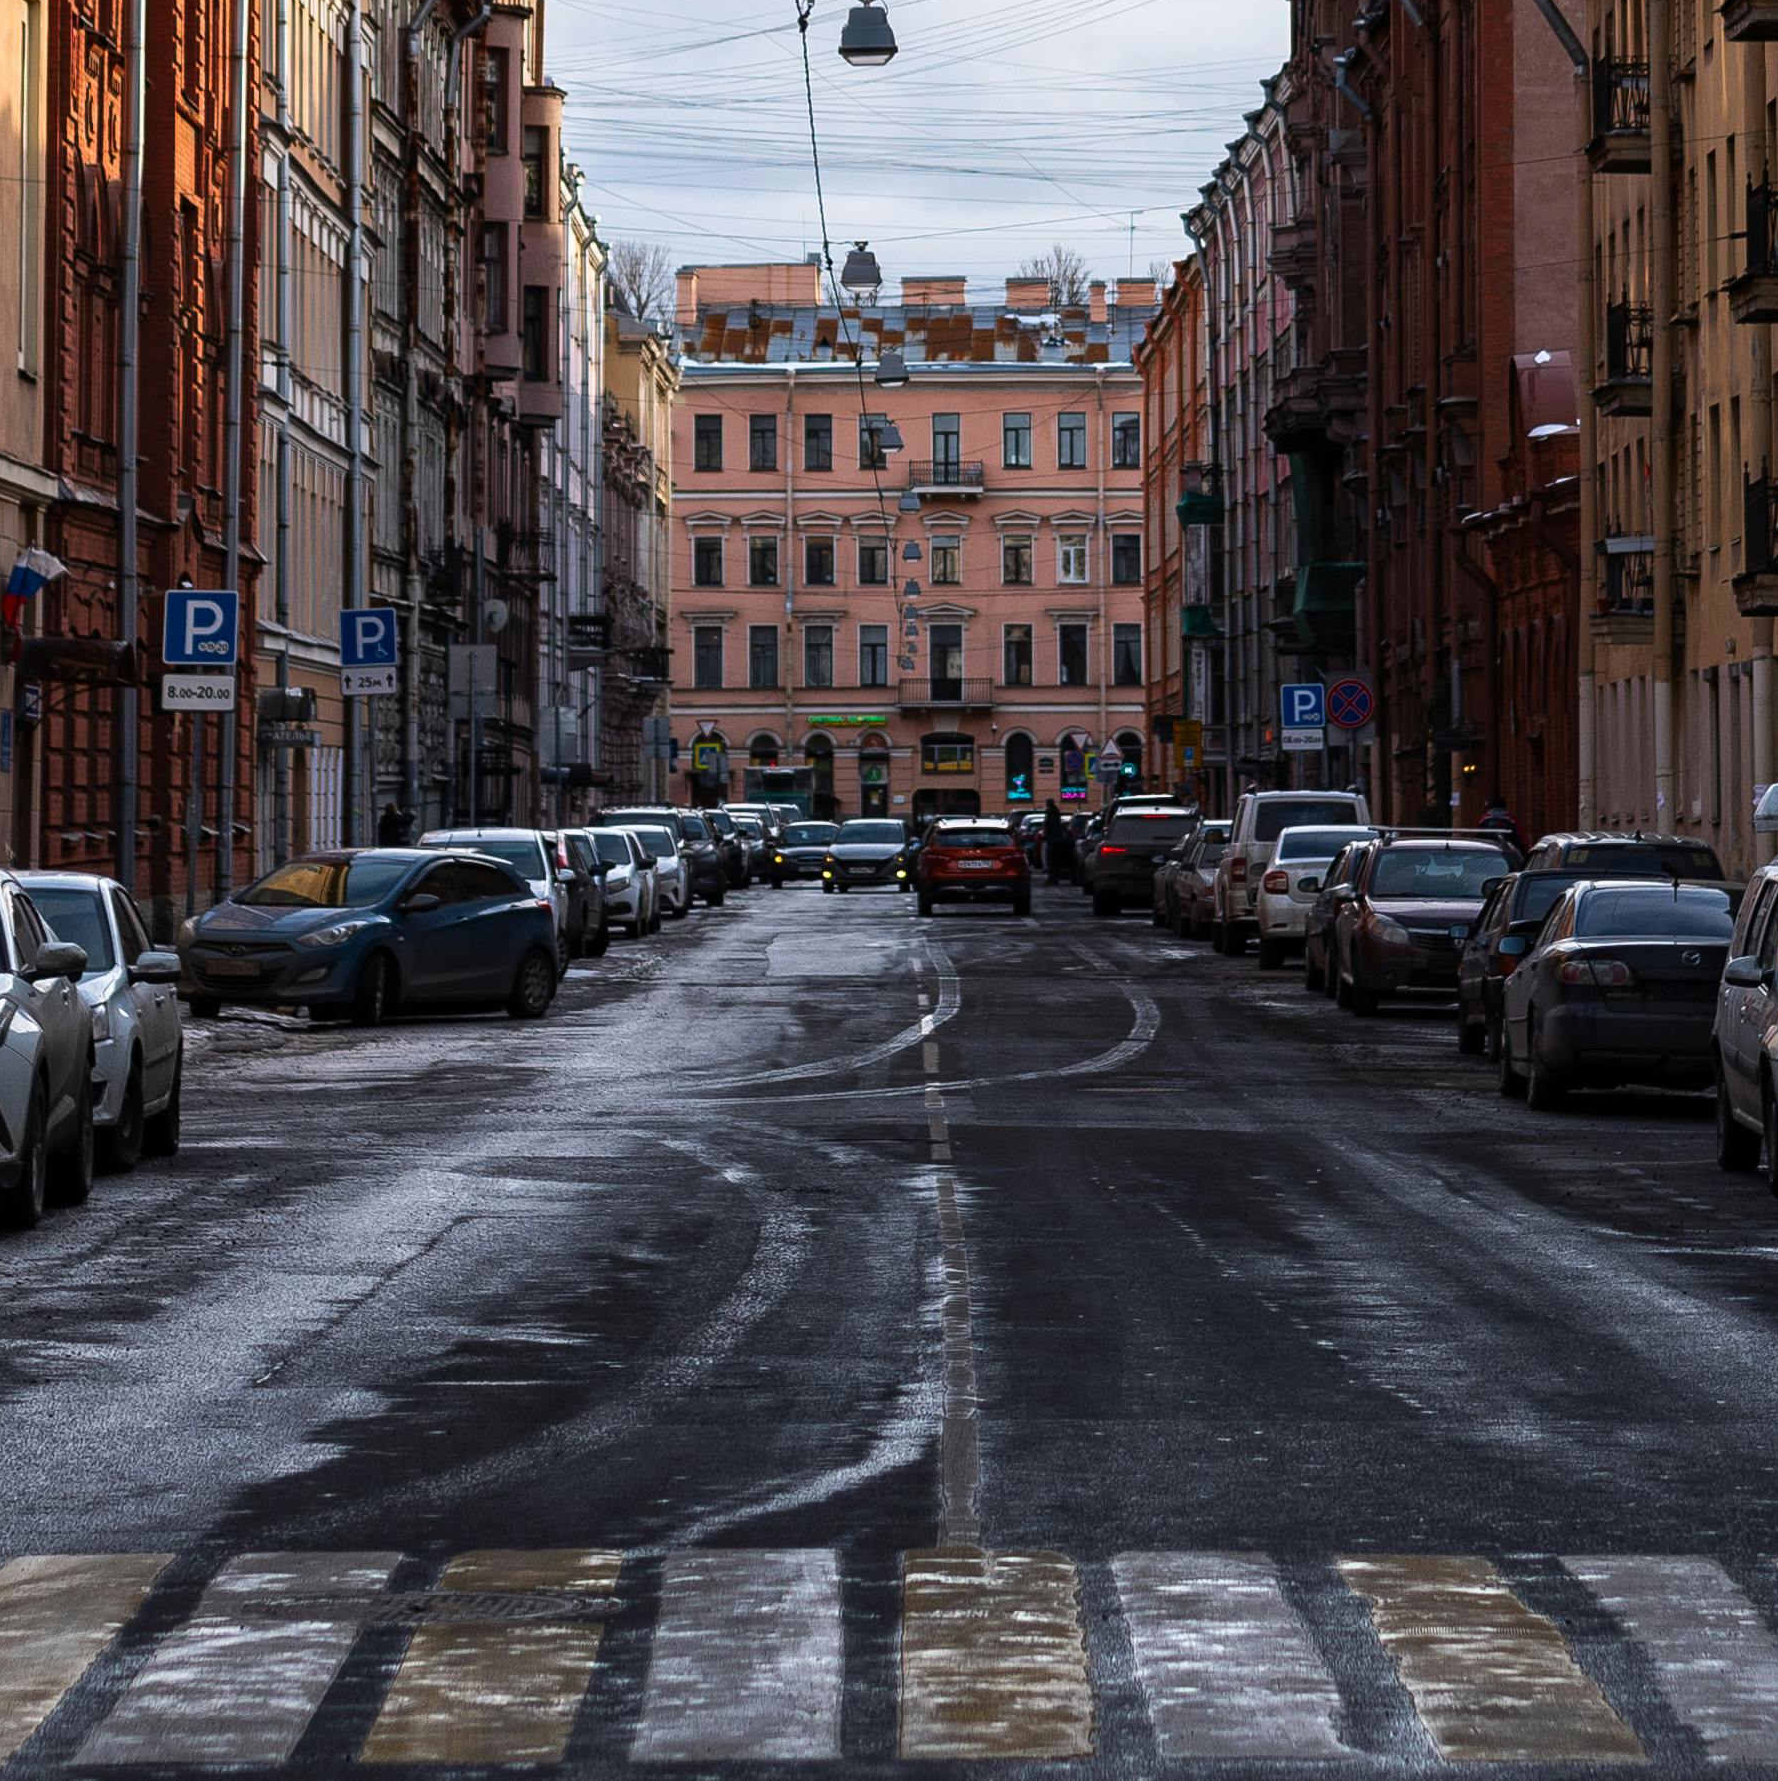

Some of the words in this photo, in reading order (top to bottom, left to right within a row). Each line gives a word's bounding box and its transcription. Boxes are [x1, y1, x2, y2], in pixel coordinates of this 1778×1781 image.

[184, 599, 223, 655] P
[355, 616, 385, 659] P
[167, 685, 230, 699] 8.00-20.00
[1293, 689, 1316, 723] P
